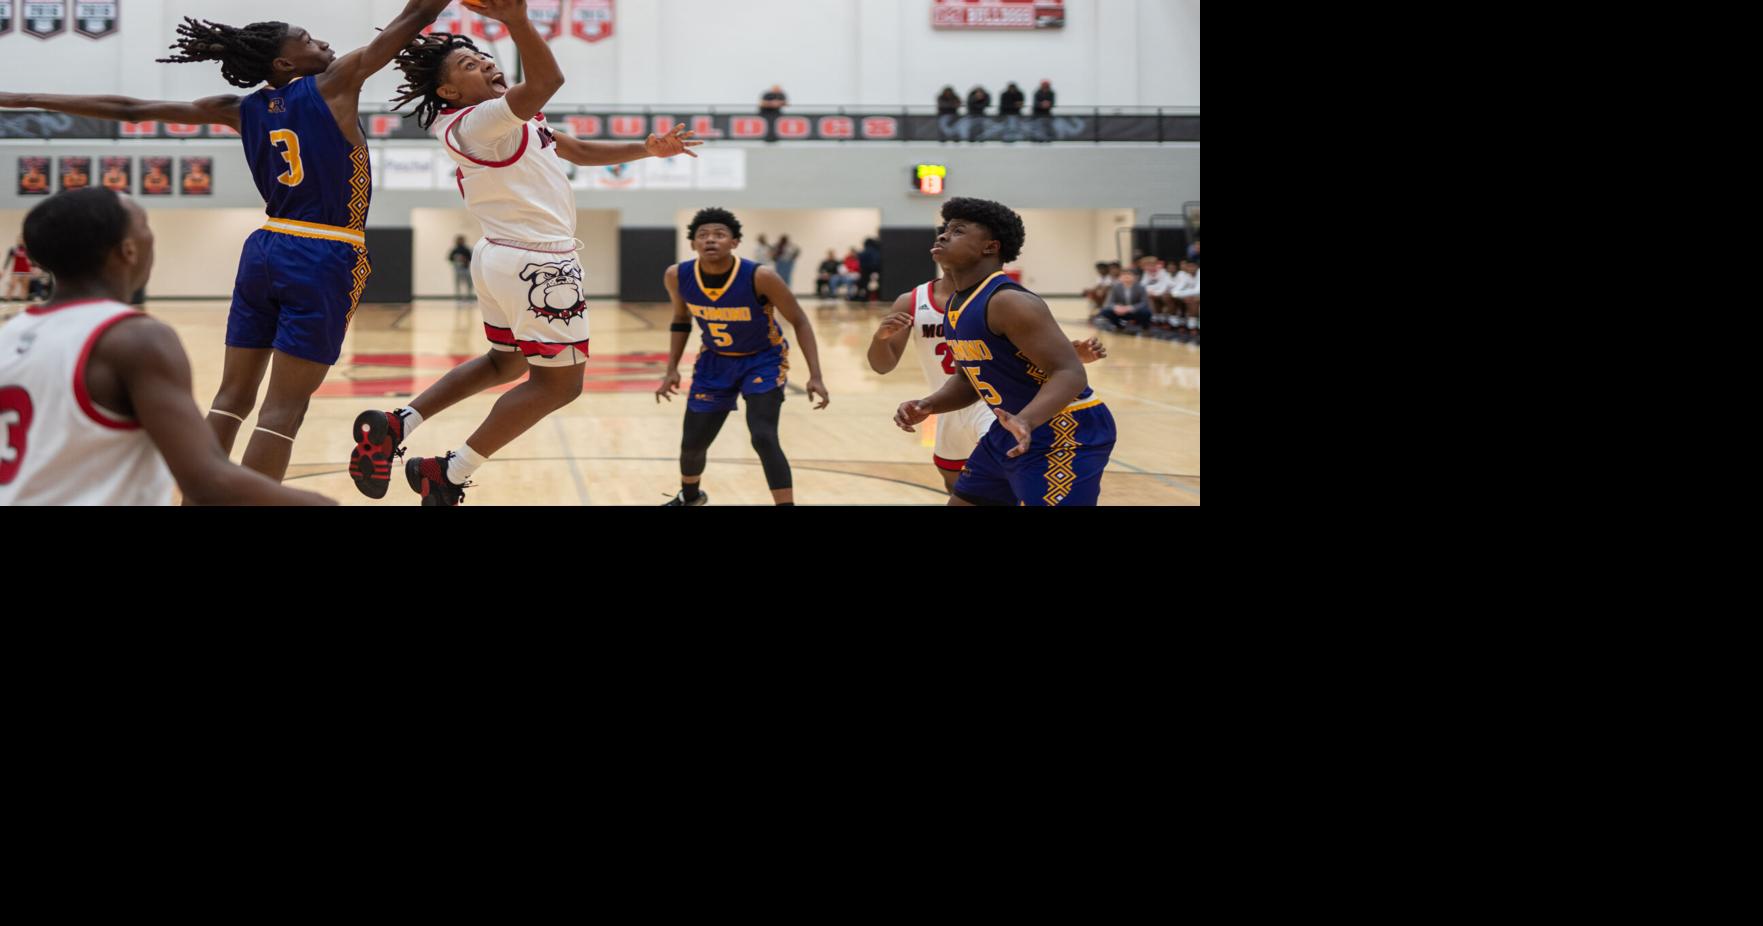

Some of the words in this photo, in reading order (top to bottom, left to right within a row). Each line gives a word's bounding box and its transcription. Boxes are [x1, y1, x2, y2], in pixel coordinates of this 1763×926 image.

[564, 115, 897, 139] BULLDOGS
[269, 128, 305, 187] 3
[707, 322, 733, 347] 5
[0, 384, 35, 486] 3
